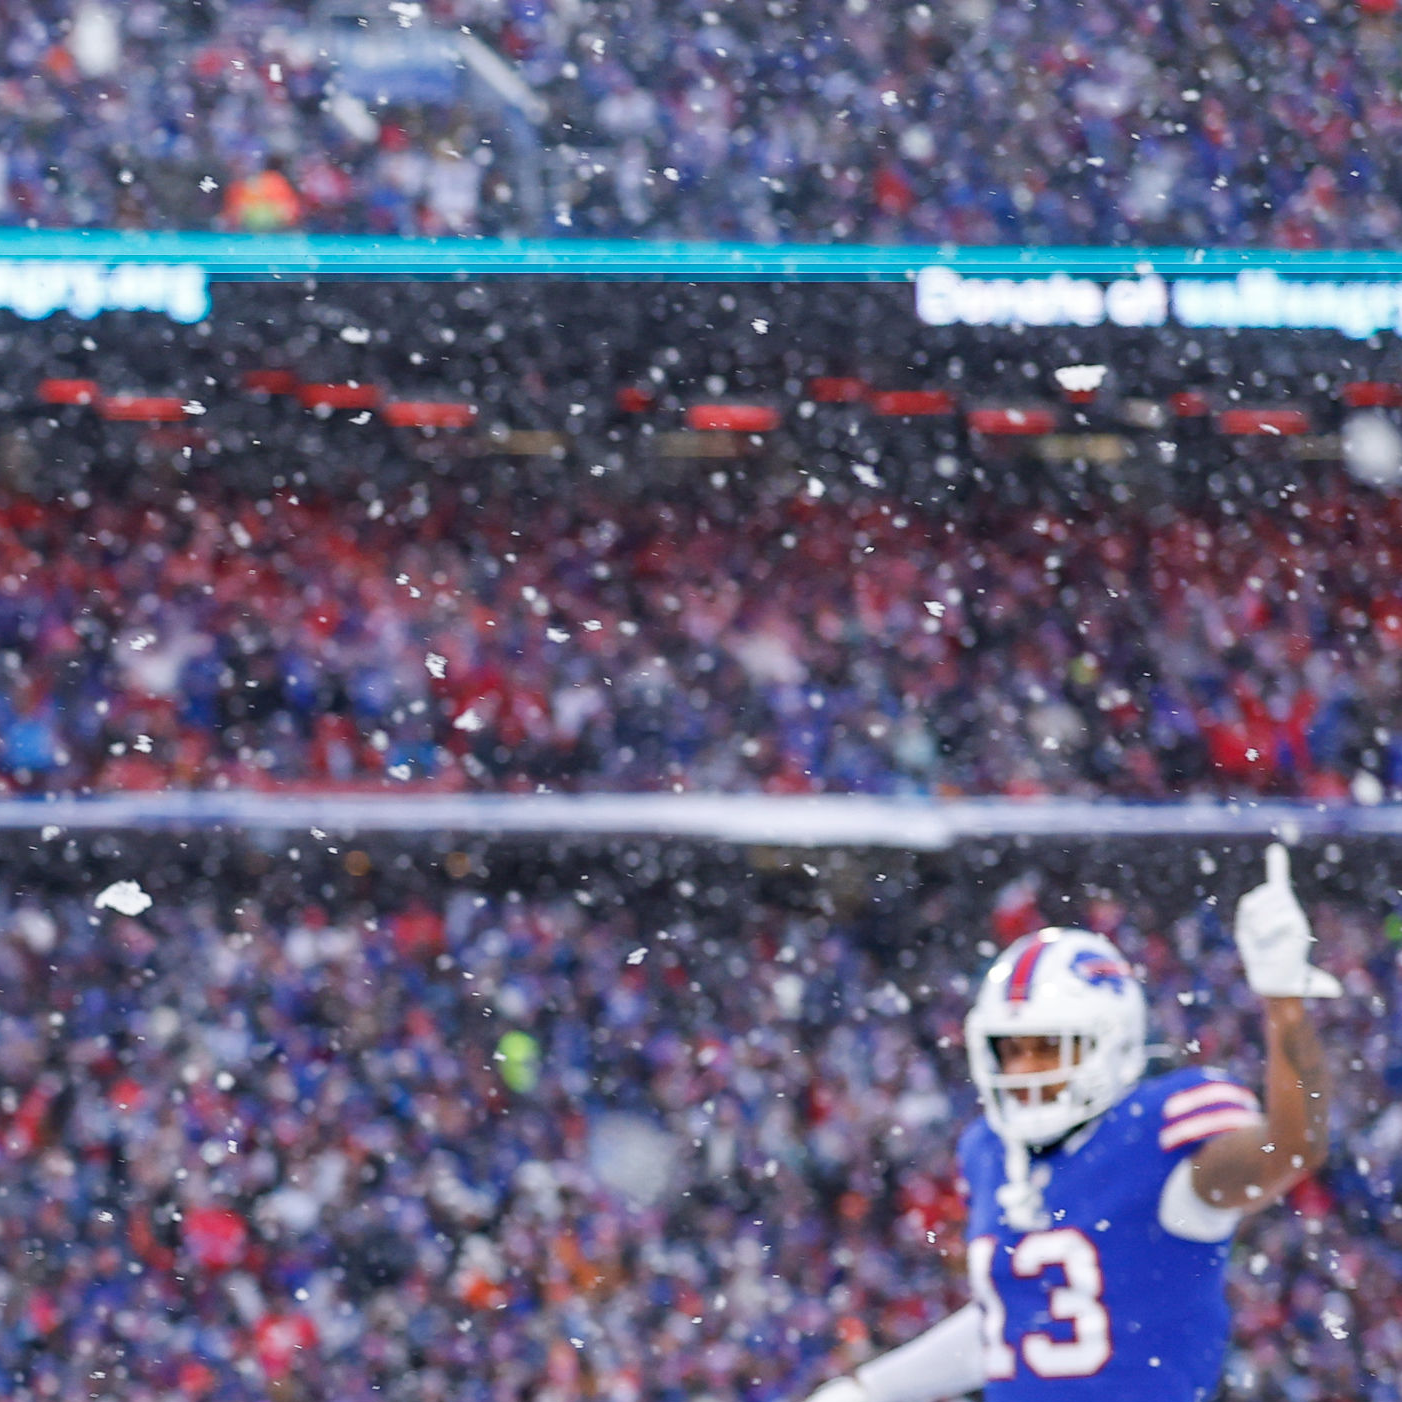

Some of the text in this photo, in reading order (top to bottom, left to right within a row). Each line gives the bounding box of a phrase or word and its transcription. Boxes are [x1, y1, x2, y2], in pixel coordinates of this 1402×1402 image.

[916, 265, 1104, 326] Donate
[1105, 272, 1167, 327] at
[967, 1227, 1113, 1379] 13
